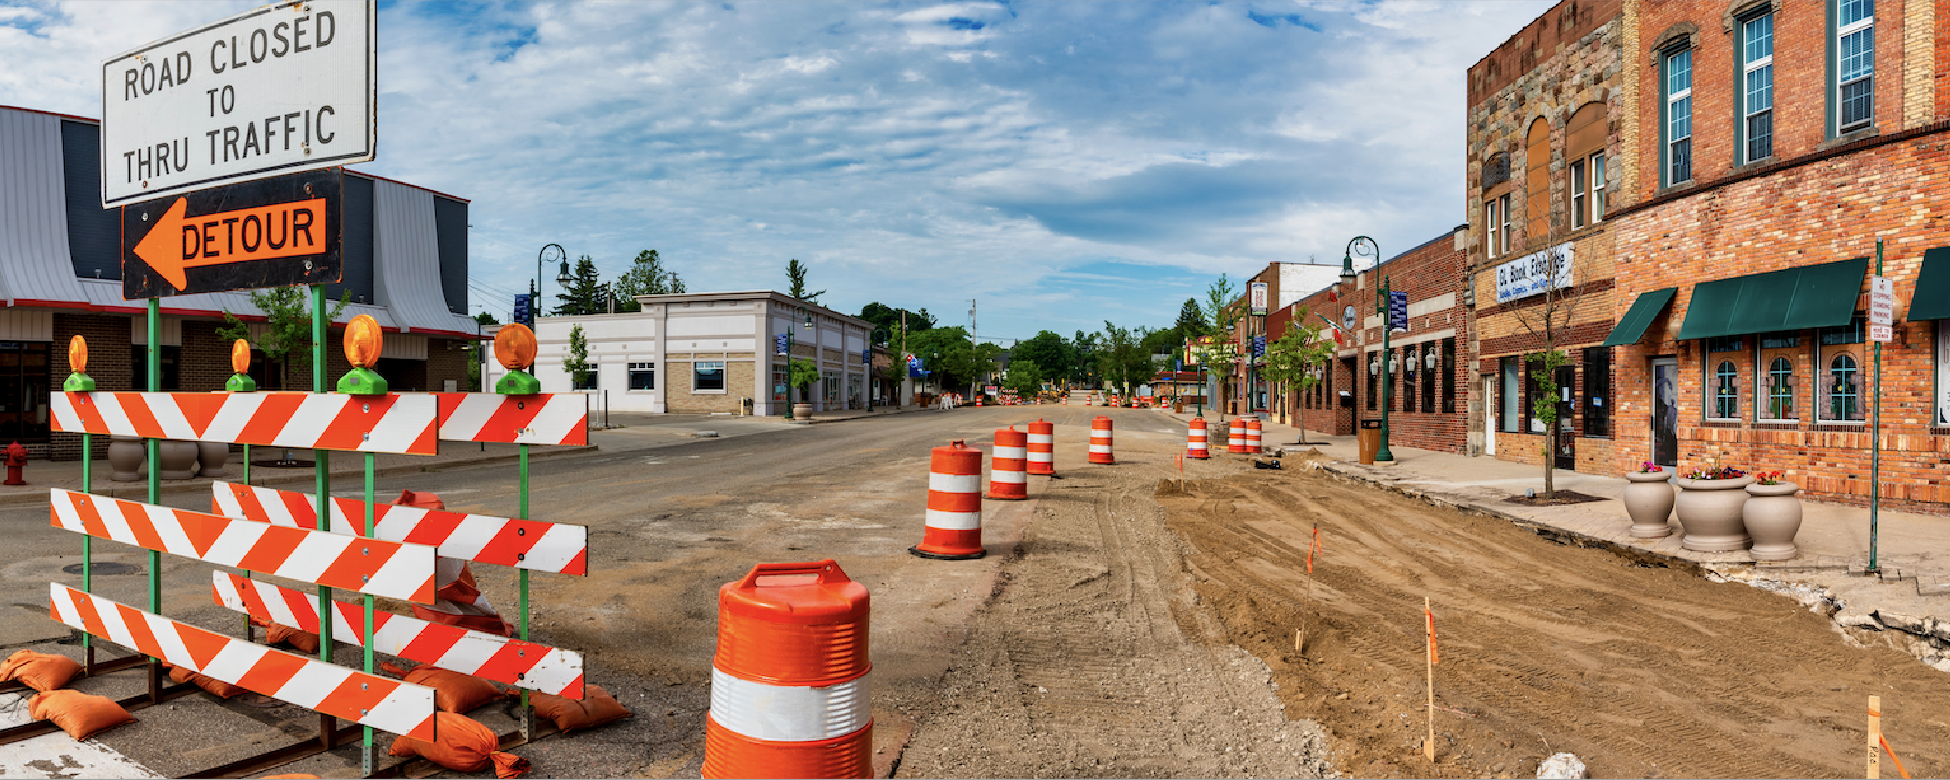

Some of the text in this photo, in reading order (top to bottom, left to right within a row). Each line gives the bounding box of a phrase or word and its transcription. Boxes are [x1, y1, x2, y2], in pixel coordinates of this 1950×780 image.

[125, 10, 336, 101] ROAD CLOSED
[206, 85, 235, 118] TO
[124, 105, 335, 183] THRU TRAFFIC
[182, 208, 314, 260] DETOUR
